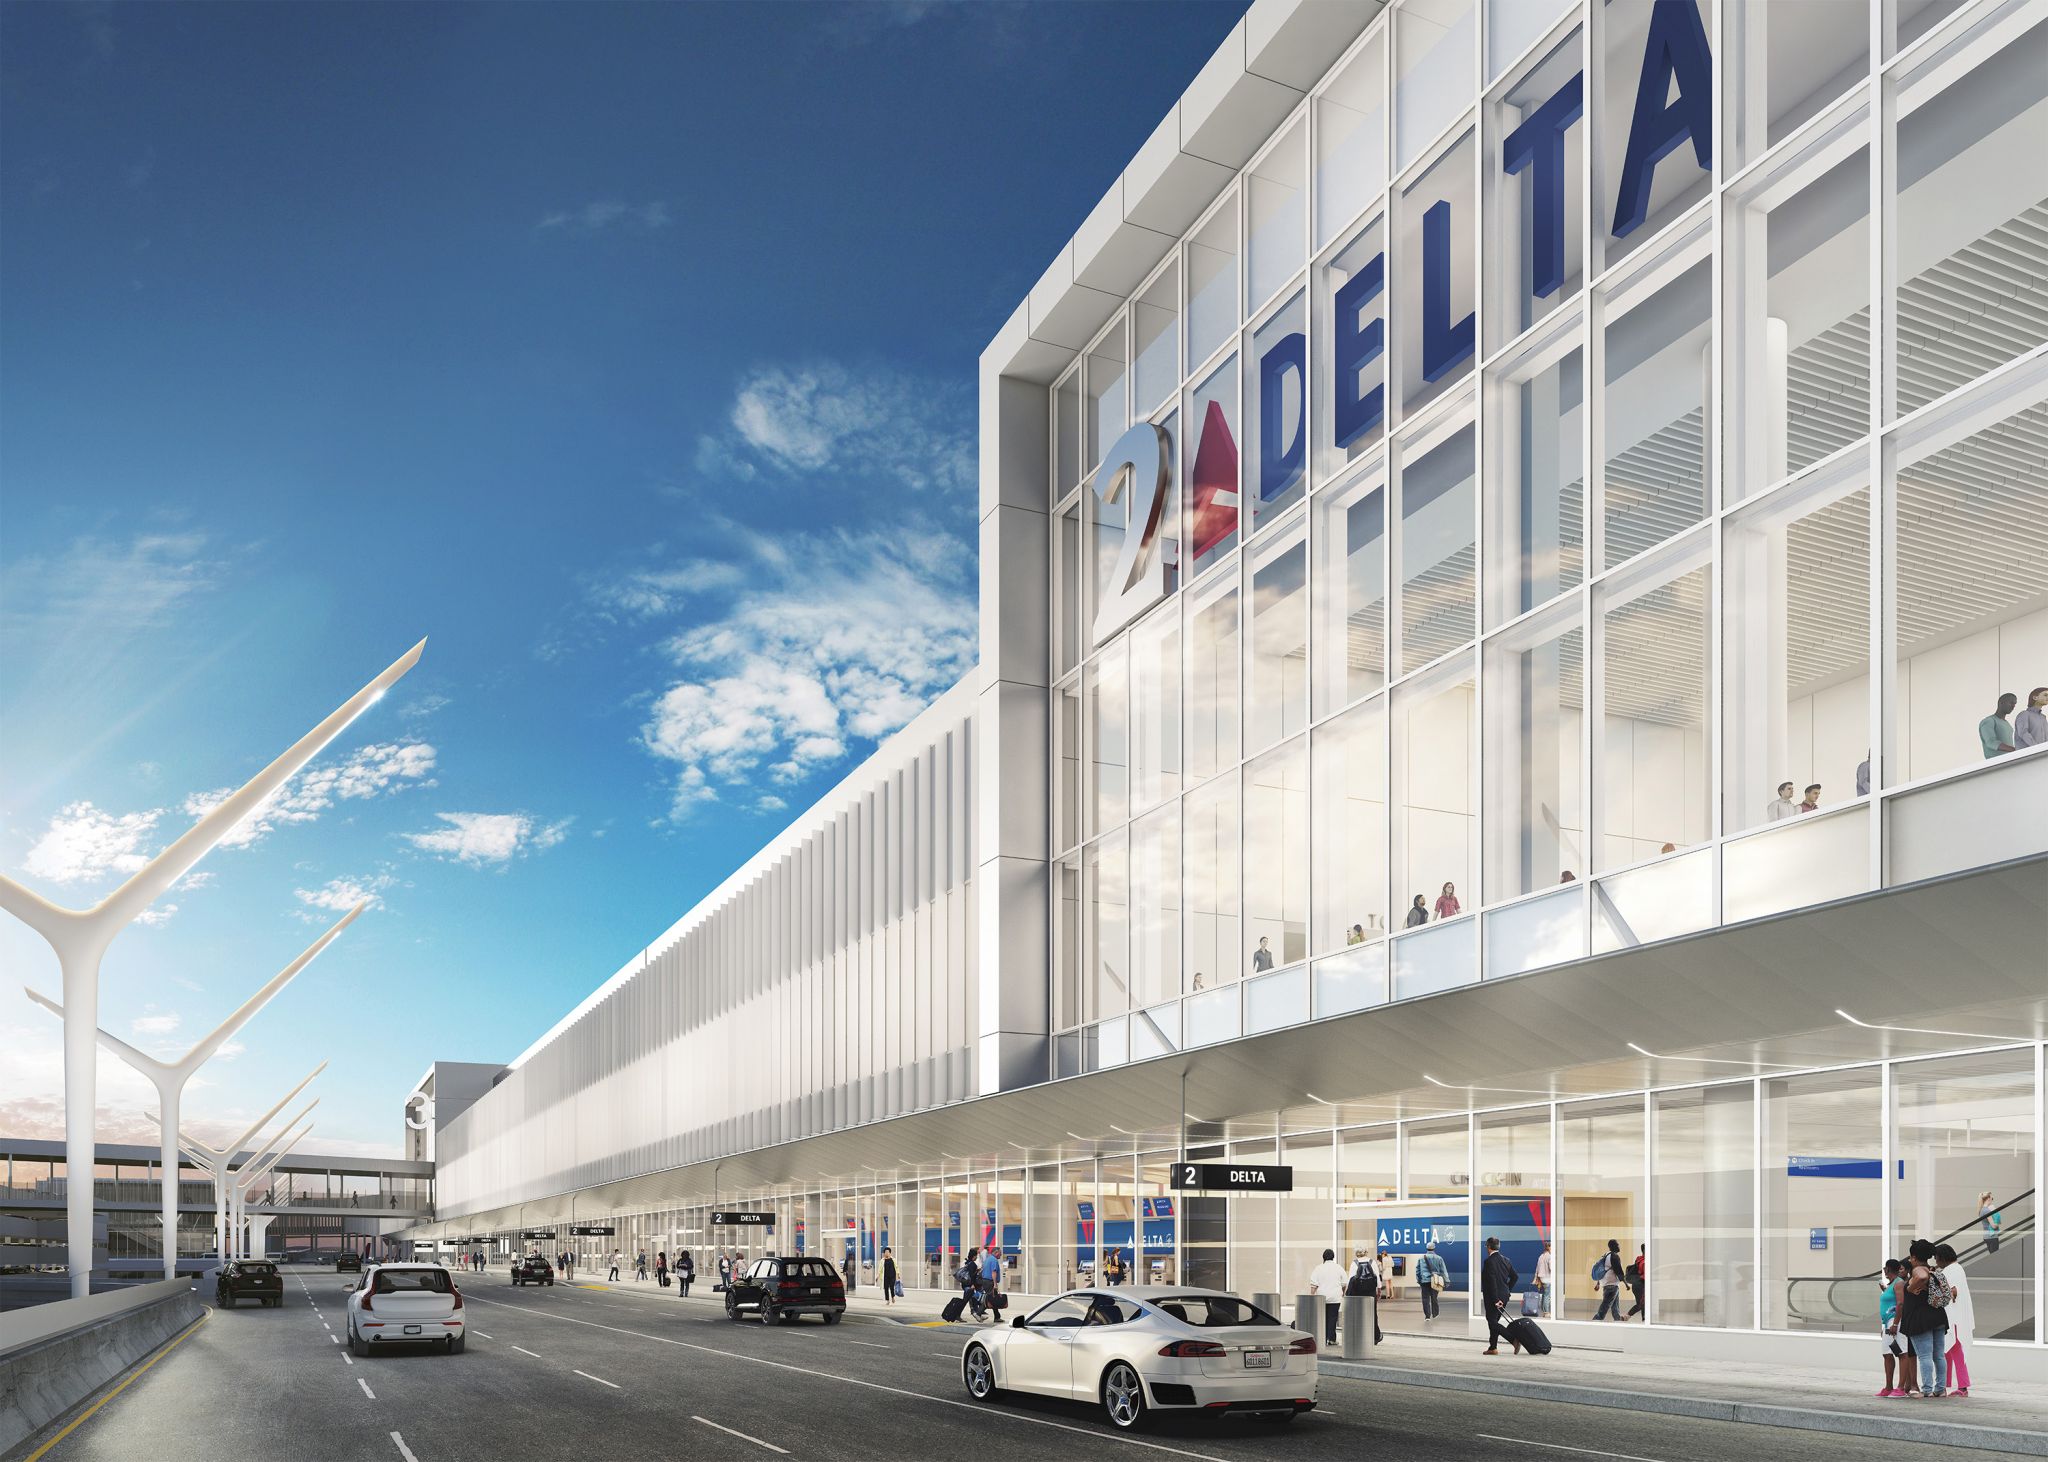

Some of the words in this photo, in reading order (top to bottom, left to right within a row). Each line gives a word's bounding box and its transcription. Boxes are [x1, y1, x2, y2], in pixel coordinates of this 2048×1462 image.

[1260, 0, 1713, 501] DELTA
[406, 1091, 432, 1130] 3
[1185, 1166, 1196, 1185] 2
[1230, 1170, 1266, 1183] DELTA
[715, 1213, 722, 1223] 2
[572, 1227, 578, 1235] 2
[1393, 1228, 1440, 1245] DELTA
[1141, 1235, 1163, 1248] ELTA
